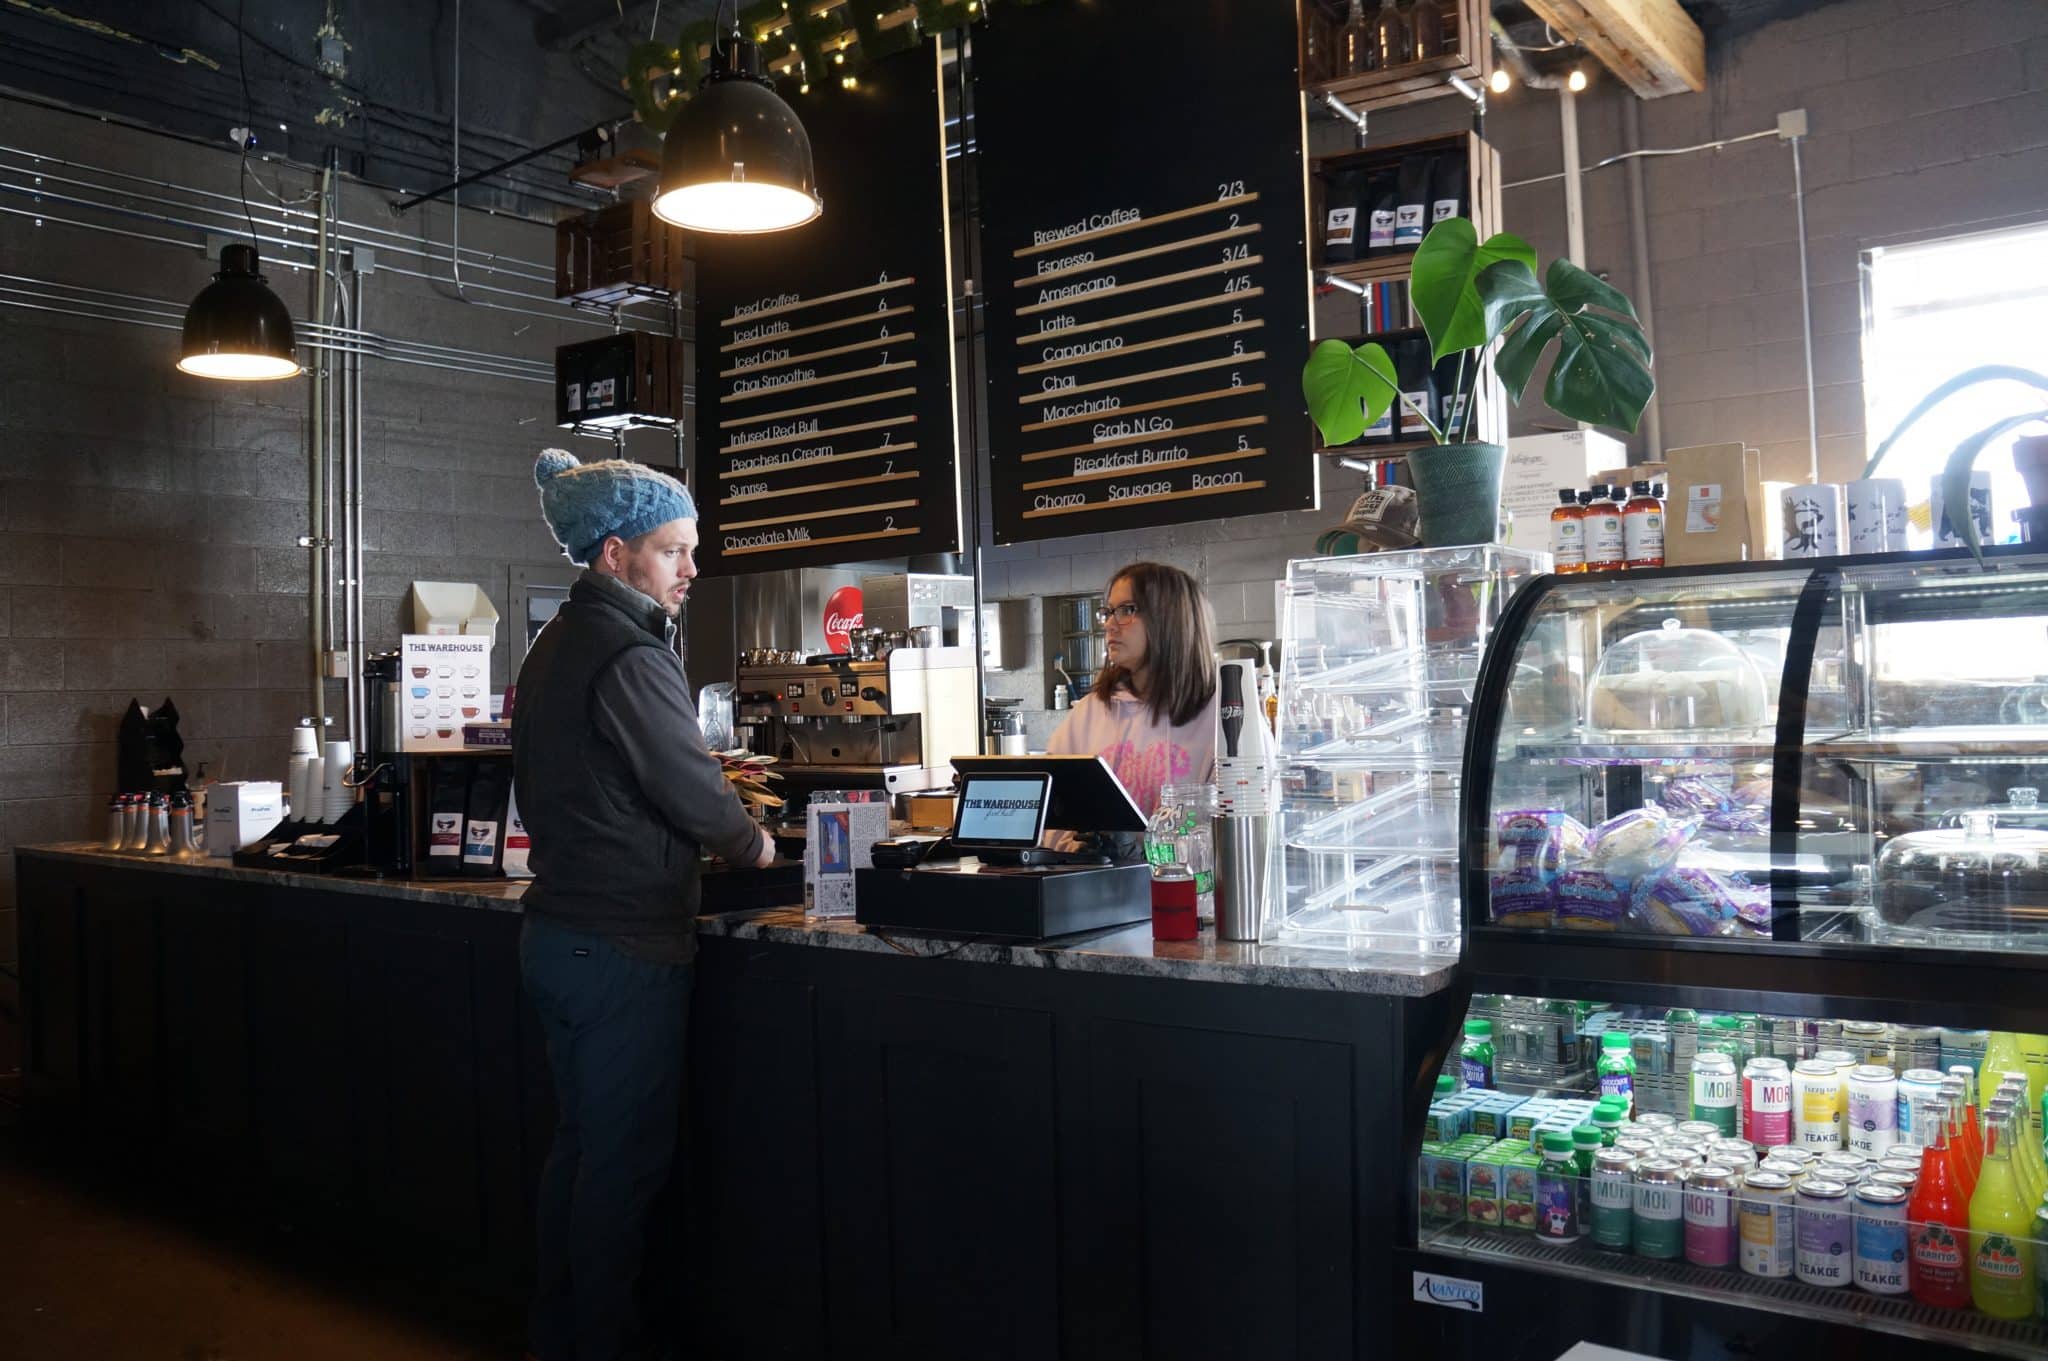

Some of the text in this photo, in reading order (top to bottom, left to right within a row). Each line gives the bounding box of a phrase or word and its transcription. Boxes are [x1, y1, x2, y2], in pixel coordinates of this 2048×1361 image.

[1034, 181, 1245, 246] Brewed Coffee 2/3
[1037, 215, 1240, 276] Espresso 2
[1038, 244, 1249, 305] Americano 3/4
[733, 271, 887, 319] Iced Coffee 6
[1040, 276, 1251, 335] Latte 4/5
[733, 298, 888, 345] Iced Latte 6
[1232, 309, 1244, 324] 5
[734, 355, 760, 369] Iced
[880, 326, 889, 340] 6
[878, 352, 891, 367] 7
[1233, 341, 1244, 356] 5
[1042, 373, 1243, 423] Macchiato 5
[731, 419, 818, 448] Infused Red Bull
[1093, 416, 1173, 444] Grab N Go
[731, 454, 780, 472] Peaches
[792, 445, 833, 462] Cream
[880, 433, 893, 448] 7
[1073, 453, 1137, 477] Breakfast
[1237, 436, 1249, 452] 5
[882, 461, 895, 476] 7
[1108, 480, 1172, 502] Sausage
[1192, 471, 1243, 490] Bacon
[724, 517, 897, 551] Chocolate Milk 2
[408, 643, 484, 652] THE WAREHOUSE
[965, 799, 1040, 810] THE WAREHOUSE
[1804, 1133, 1839, 1143] TEAKOE
[1850, 1139, 1872, 1151] AKOE
[1800, 1264, 1840, 1278] TEAKOE
[1858, 1270, 1902, 1285] TEAKOE
